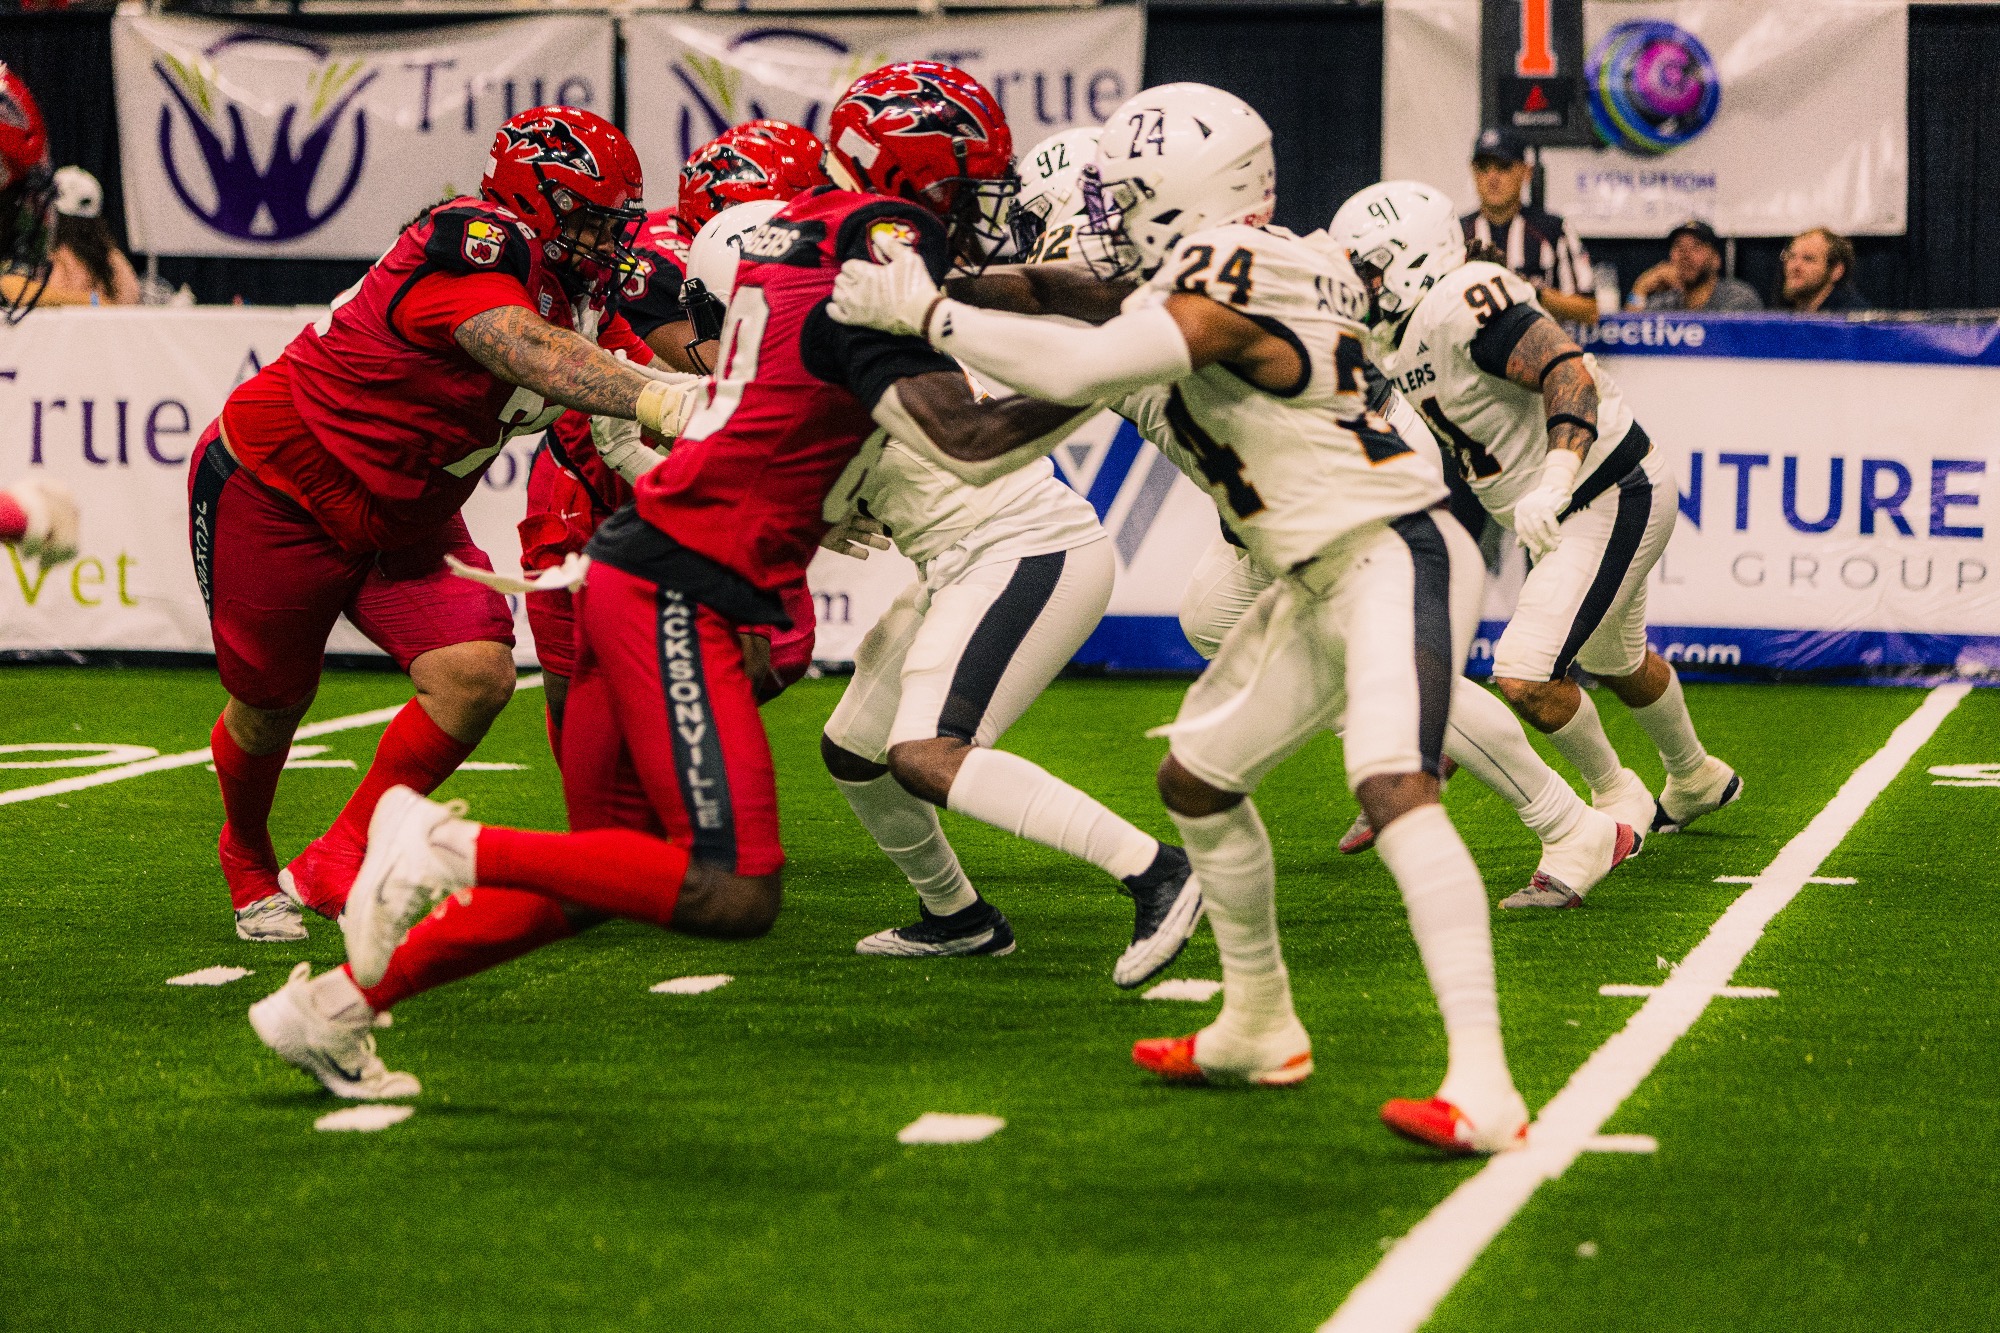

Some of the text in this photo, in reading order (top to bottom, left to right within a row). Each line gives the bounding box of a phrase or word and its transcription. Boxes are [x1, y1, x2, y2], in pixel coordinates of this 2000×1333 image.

[1128, 108, 1165, 159] 24
[1036, 143, 1070, 179] 92
[1367, 197, 1400, 229] 91
[1175, 245, 1254, 307] 24
[1463, 274, 1516, 328] 91
[1389, 363, 1437, 395] LERS
[1730, 552, 1988, 592] GROUP
